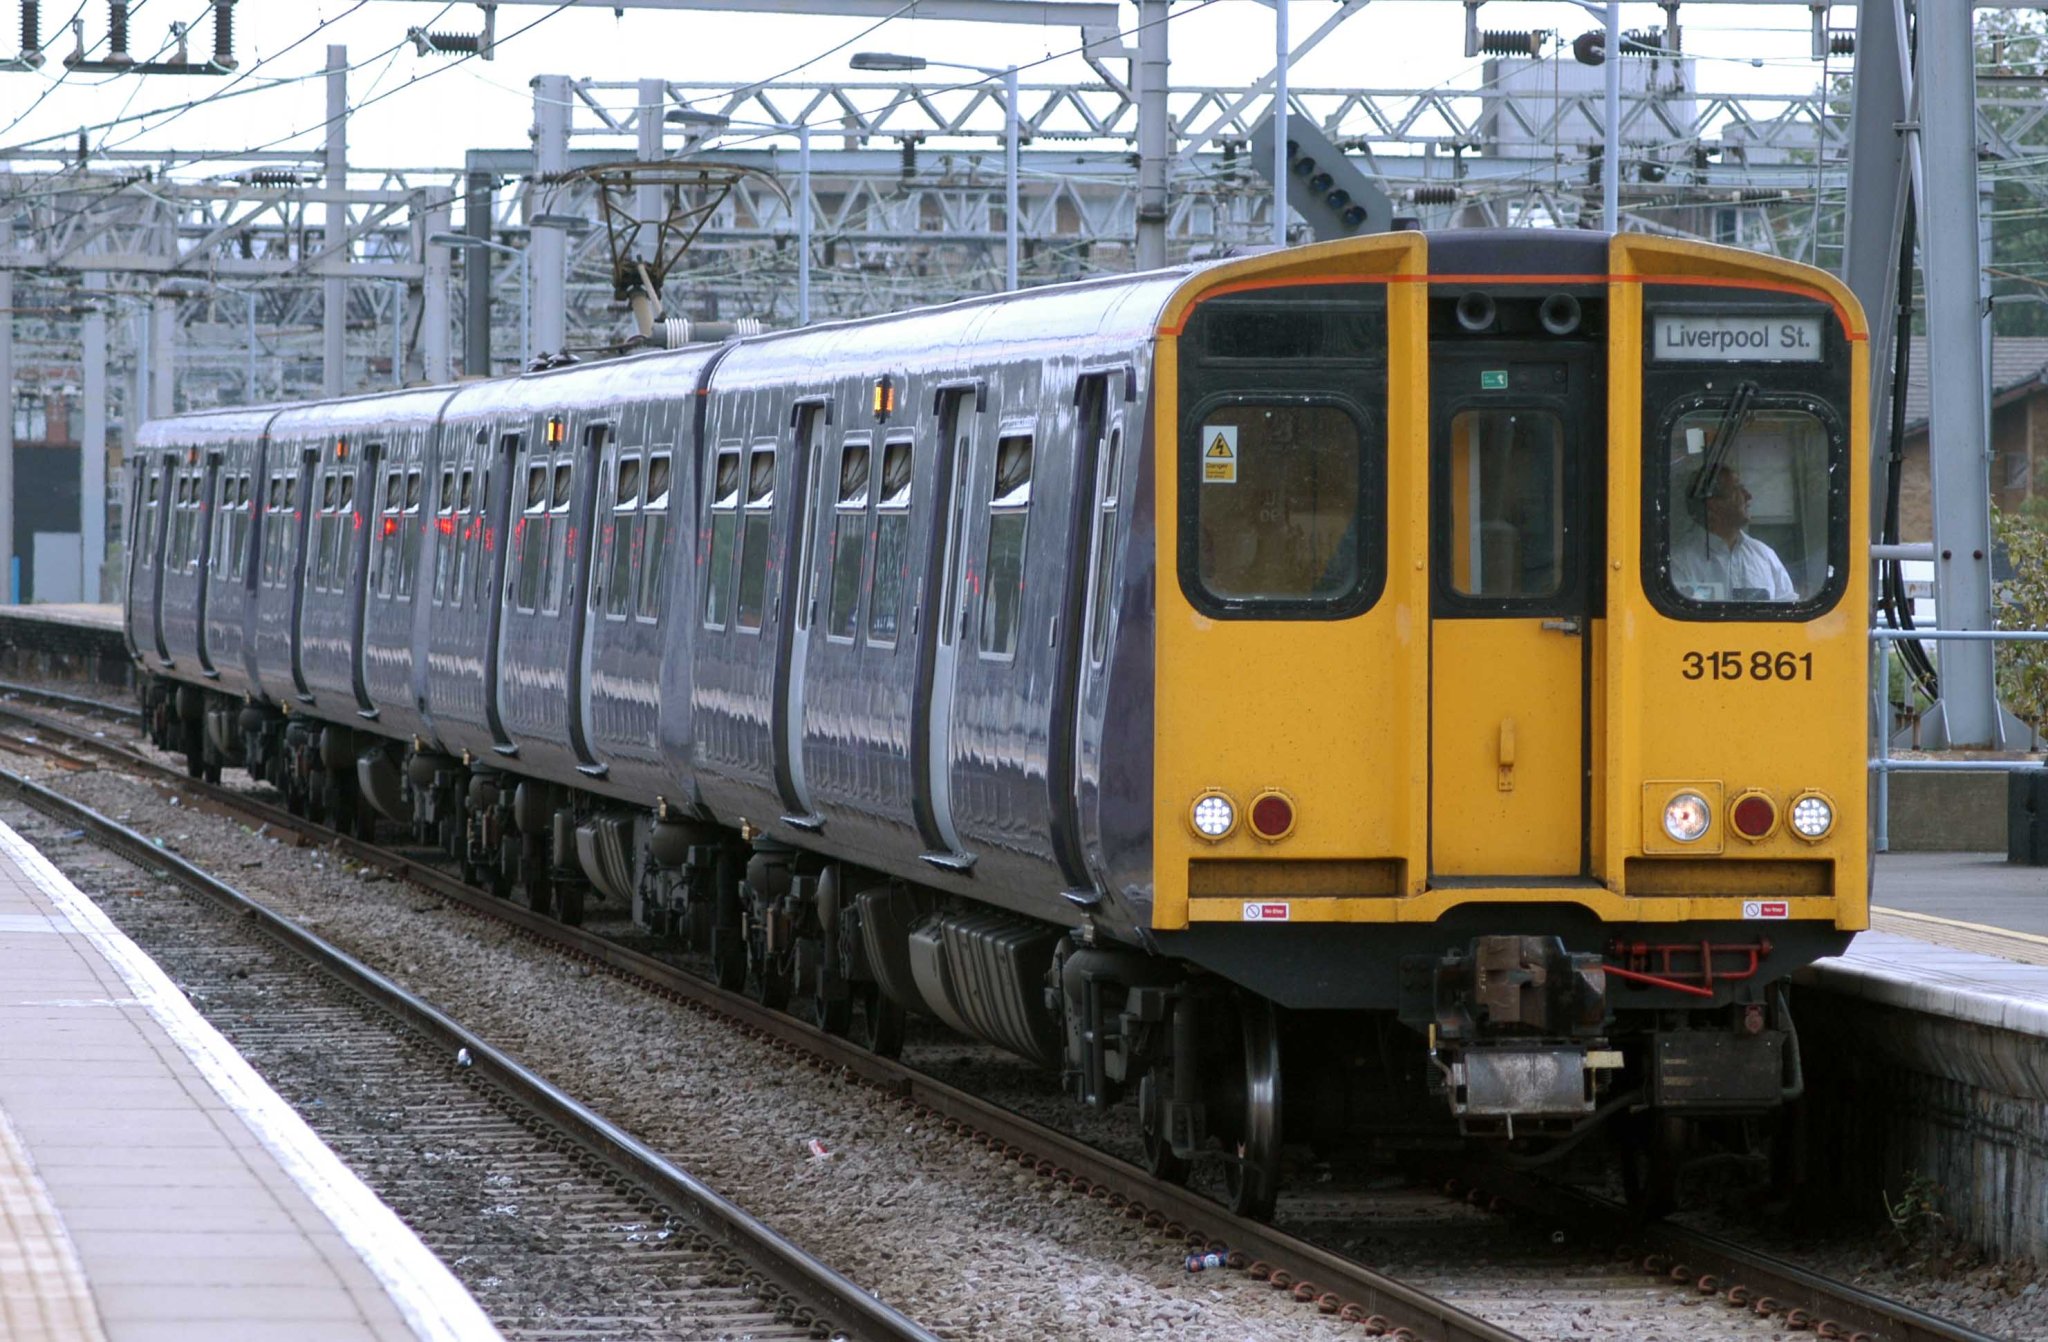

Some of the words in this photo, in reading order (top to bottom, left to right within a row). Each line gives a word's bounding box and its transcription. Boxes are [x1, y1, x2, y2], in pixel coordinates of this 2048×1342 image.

[1666, 325, 1769, 352] Liverpool
[1780, 325, 1810, 348] St.
[1682, 651, 1742, 680] 315
[1750, 651, 1812, 680] 861
